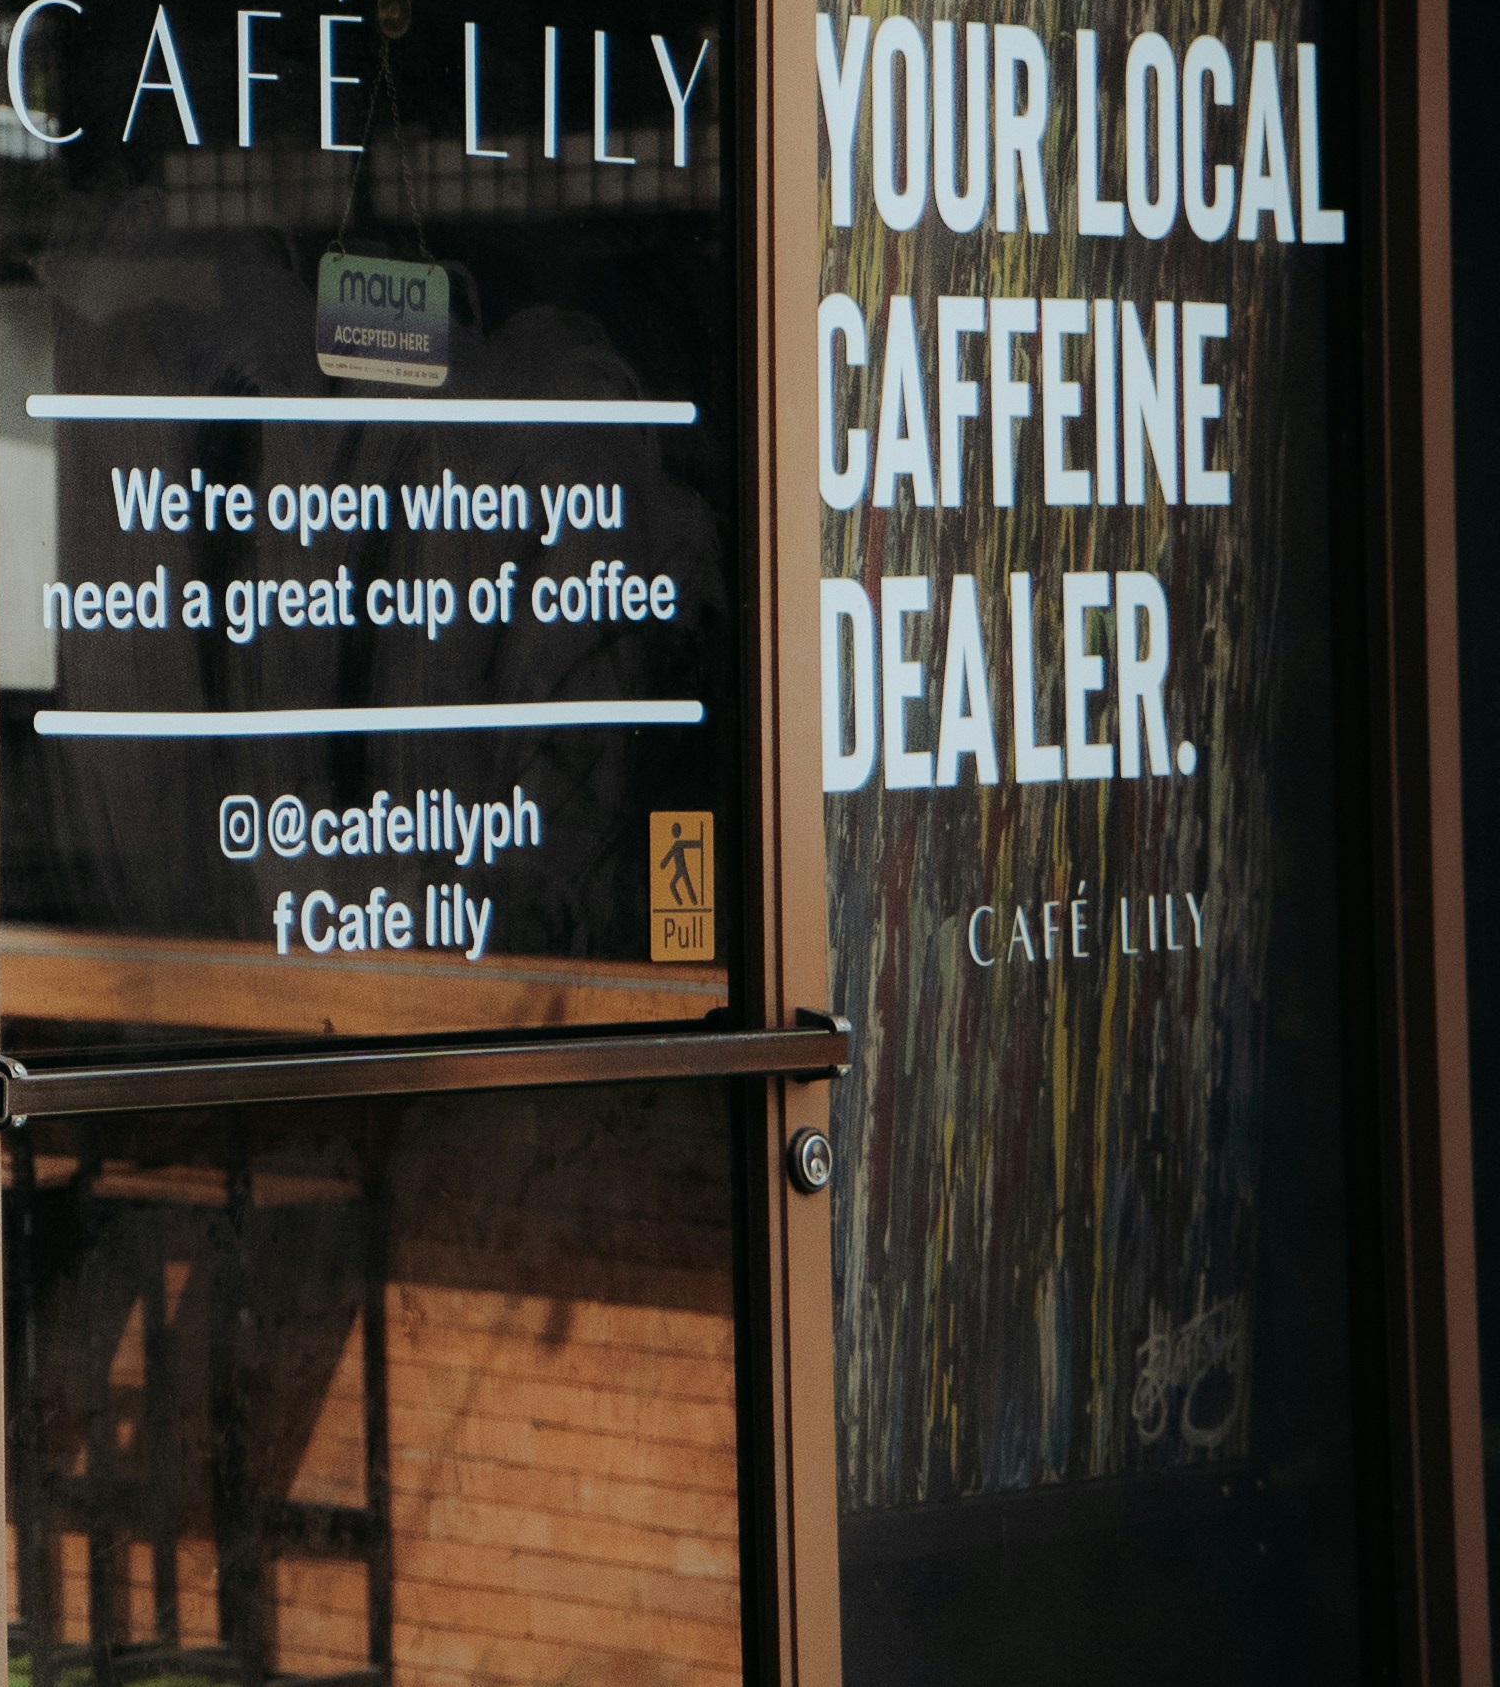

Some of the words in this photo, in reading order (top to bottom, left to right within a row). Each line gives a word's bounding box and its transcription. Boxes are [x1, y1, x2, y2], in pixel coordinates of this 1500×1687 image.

[464, 22, 710, 167] LILY
[816, 13, 1047, 233] YOUR
[1075, 28, 1345, 243] LOCAL
[338, 269, 427, 321] maya
[333, 324, 397, 349] ACCEPTED
[399, 332, 430, 353] HERE
[817, 292, 1230, 510] CAFFEINE
[112, 468, 252, 530] We're
[268, 484, 385, 546] open
[401, 469, 526, 529] when
[541, 484, 620, 545] you
[42, 564, 166, 631] need
[182, 581, 209, 627] a
[226, 565, 354, 642] great
[367, 579, 454, 640] cup
[469, 562, 515, 623] of
[532, 561, 674, 622] coffee
[819, 570, 1197, 793] DEALER.
[268, 786, 538, 865] @cafelilyph
[301, 887, 410, 952] Cafe
[426, 884, 490, 960] lily
[663, 915, 704, 949] Pull
[968, 880, 1089, 967] CAFÉ
[1120, 891, 1205, 955] LILY
